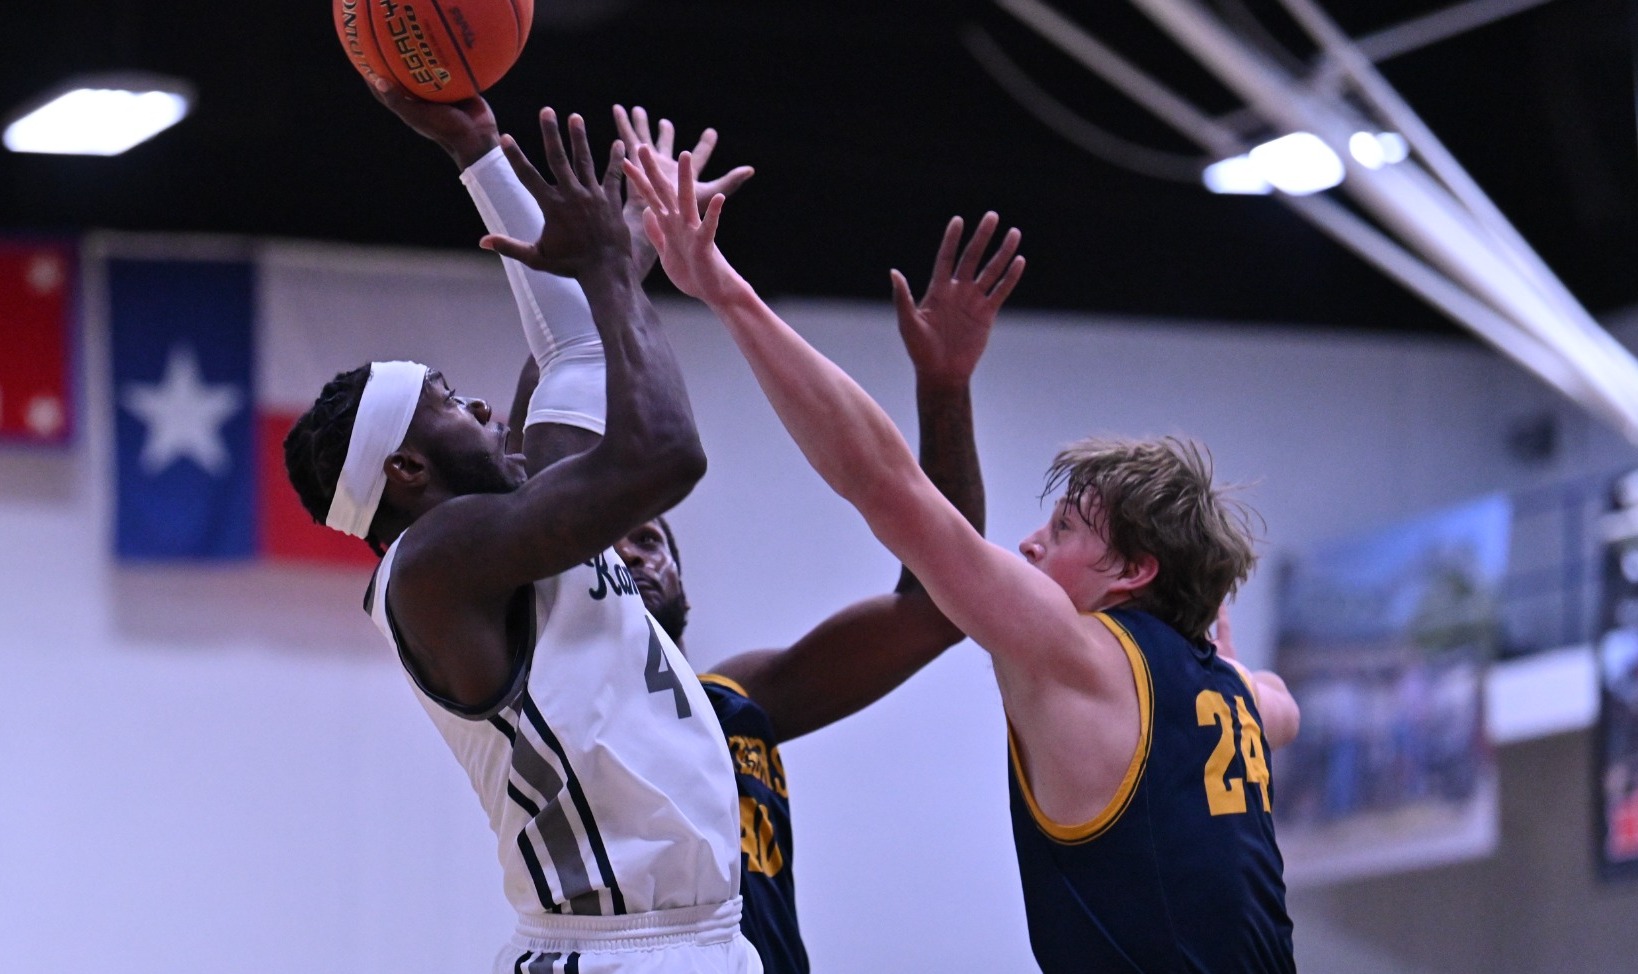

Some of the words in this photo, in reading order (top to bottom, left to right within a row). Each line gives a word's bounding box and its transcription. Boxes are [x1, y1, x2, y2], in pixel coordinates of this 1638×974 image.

[379, 0, 442, 93] LEGACY
[403, 4, 438, 66] 1000
[644, 614, 692, 719] 4
[1195, 689, 1272, 817] 24
